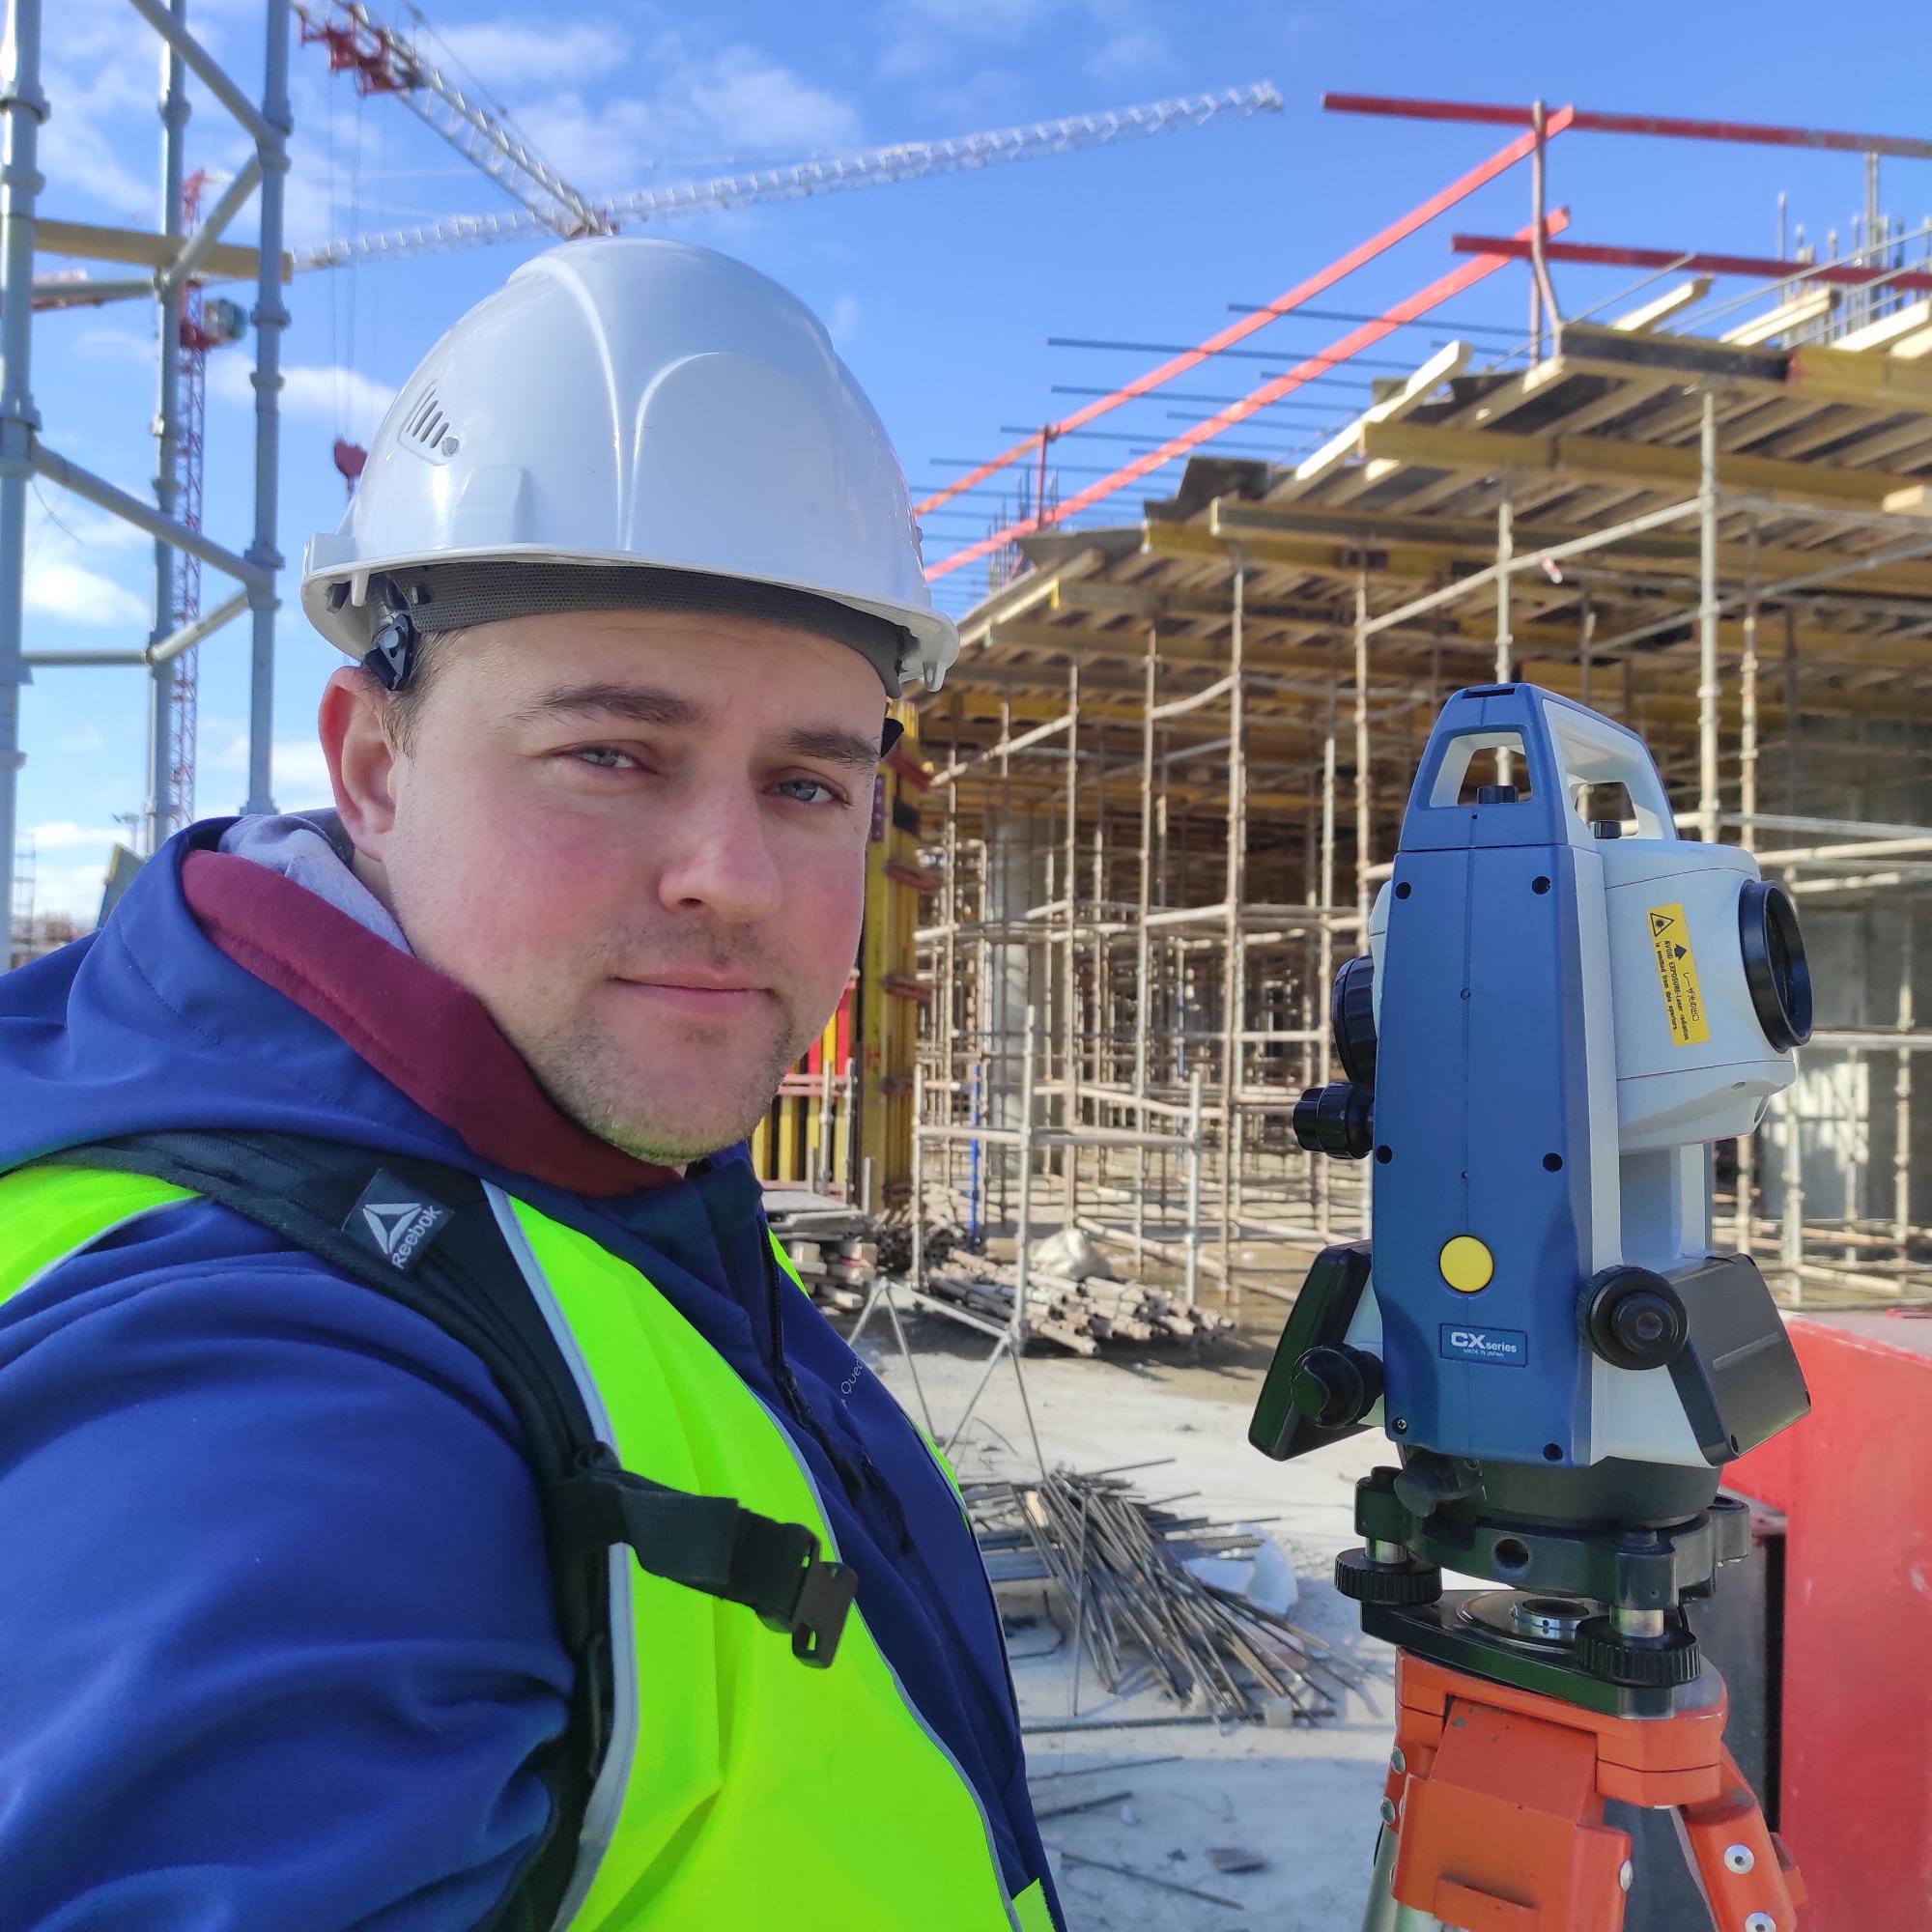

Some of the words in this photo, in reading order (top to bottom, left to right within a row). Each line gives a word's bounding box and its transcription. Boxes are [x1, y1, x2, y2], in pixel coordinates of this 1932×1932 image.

[1663, 940, 1674, 959] AVOID
[1680, 1013, 1690, 1041] radiation
[391, 1206, 443, 1270] Reebok
[1451, 1331, 1486, 1350] CX
[1486, 1342, 1517, 1352] series
